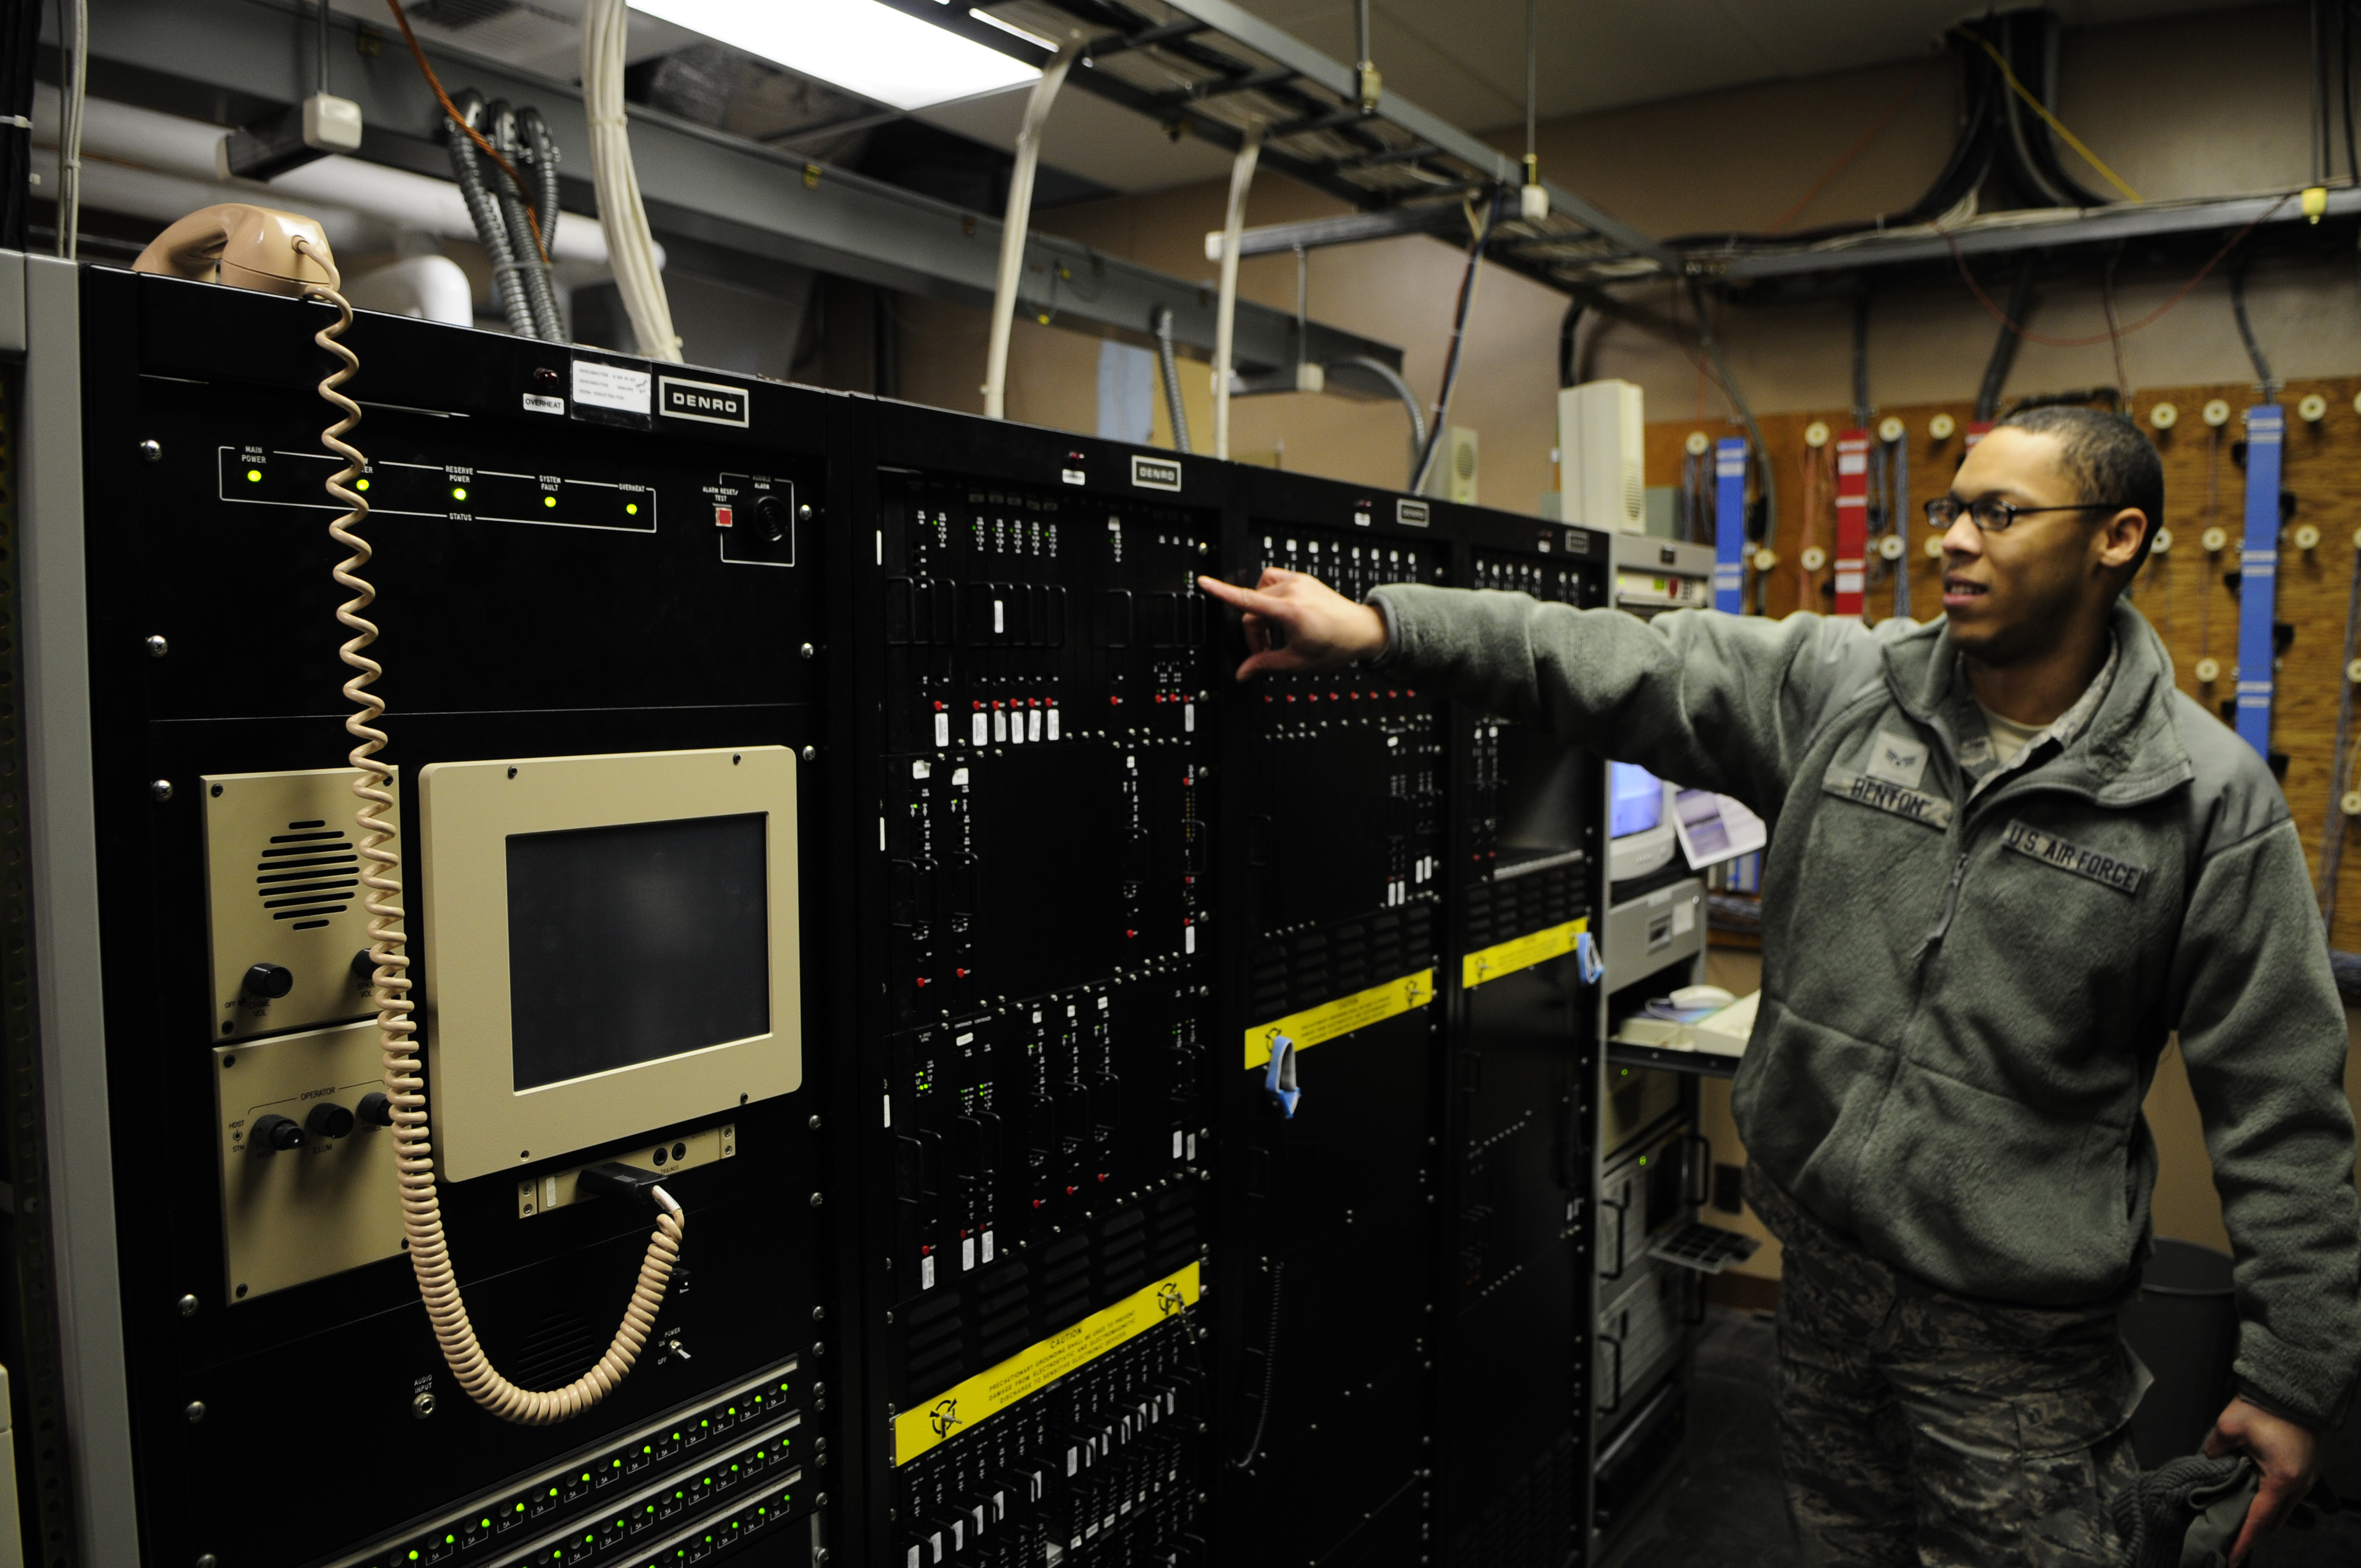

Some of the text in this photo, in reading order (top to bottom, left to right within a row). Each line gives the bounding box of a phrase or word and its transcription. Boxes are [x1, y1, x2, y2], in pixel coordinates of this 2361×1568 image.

[525, 398, 561, 409] OVERHEAT
[673, 392, 737, 413] DENRO
[242, 455, 266, 463] POWER
[446, 466, 473, 475] RESERVE
[1139, 467, 1174, 481] DENRO
[449, 475, 470, 483] POWER
[539, 475, 561, 483] SYSTEM
[619, 483, 645, 492] OVERHEAT
[449, 513, 472, 521] STATUS
[2044, 839, 2076, 866] AIR
[2076, 850, 2138, 888] FORCE
[358, 981, 375, 990] SPKR
[301, 1087, 335, 1101] OPERATOR
[229, 1120, 244, 1129] HDST
[232, 1145, 244, 1153] STN
[660, 1165, 680, 1174] TRAINEE
[1051, 1327, 1082, 1349] CAUTION
[657, 1357, 667, 1365] OFF
[414, 1374, 432, 1386] AUDIO
[415, 1382, 432, 1394] INPUT
